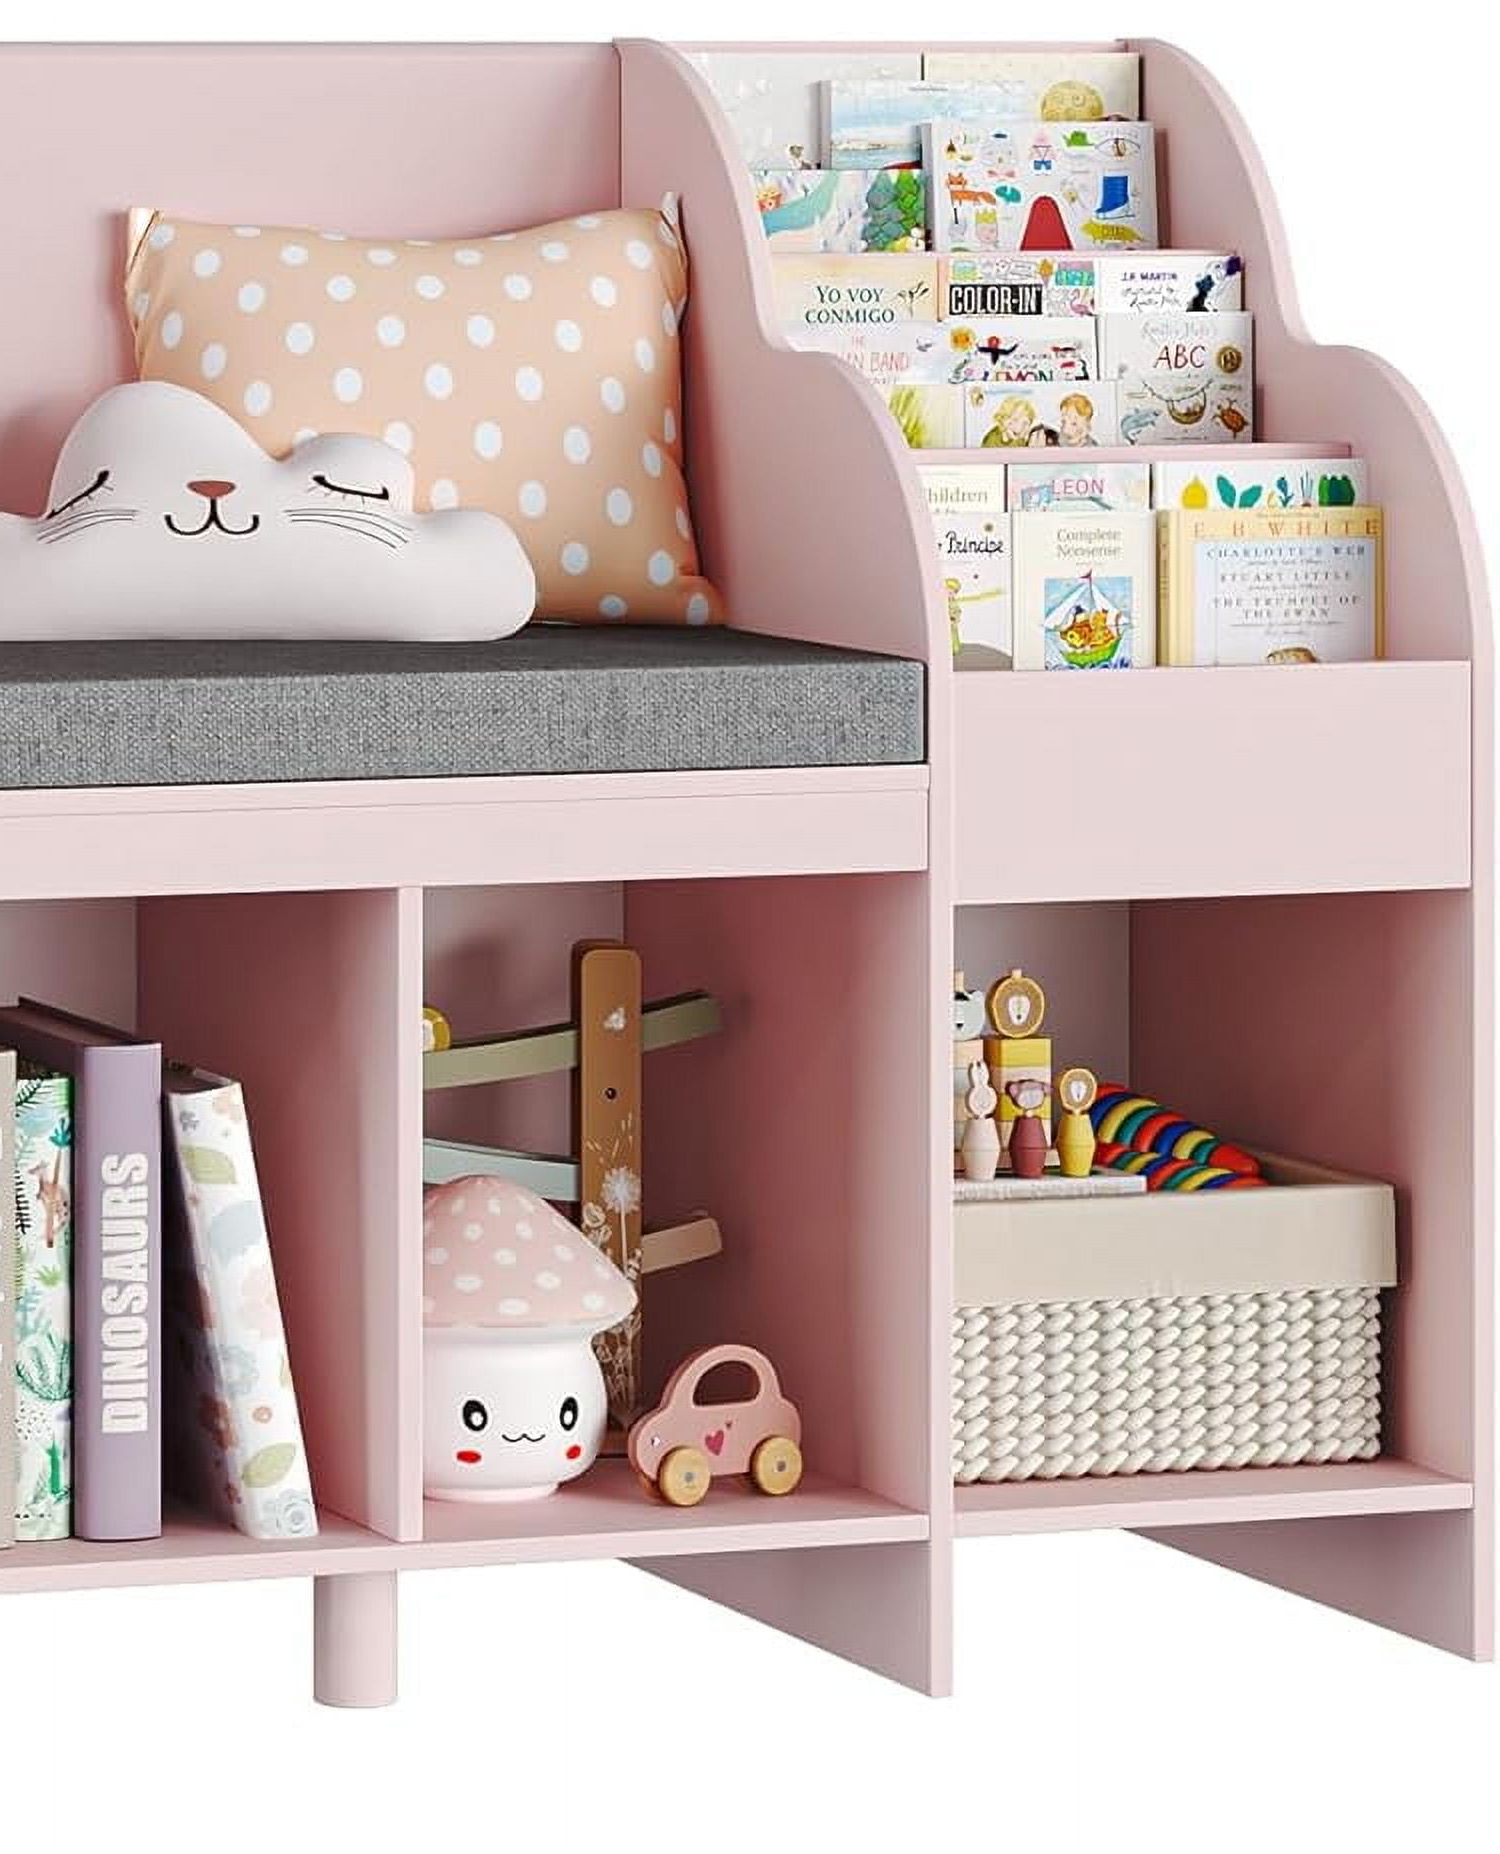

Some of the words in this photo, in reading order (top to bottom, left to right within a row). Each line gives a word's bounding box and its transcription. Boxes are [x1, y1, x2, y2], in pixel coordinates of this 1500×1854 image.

[816, 285, 841, 303] YO
[847, 287, 884, 302] VOY
[951, 286, 1038, 313] COLOR-IN
[804, 308, 896, 324] CONMIGO
[1152, 343, 1207, 370] ABC
[927, 487, 988, 503] hildren
[1051, 478, 1105, 495] LEON
[1056, 527, 1122, 544] Complete
[101, 1151, 149, 1434] DINOSAURS
